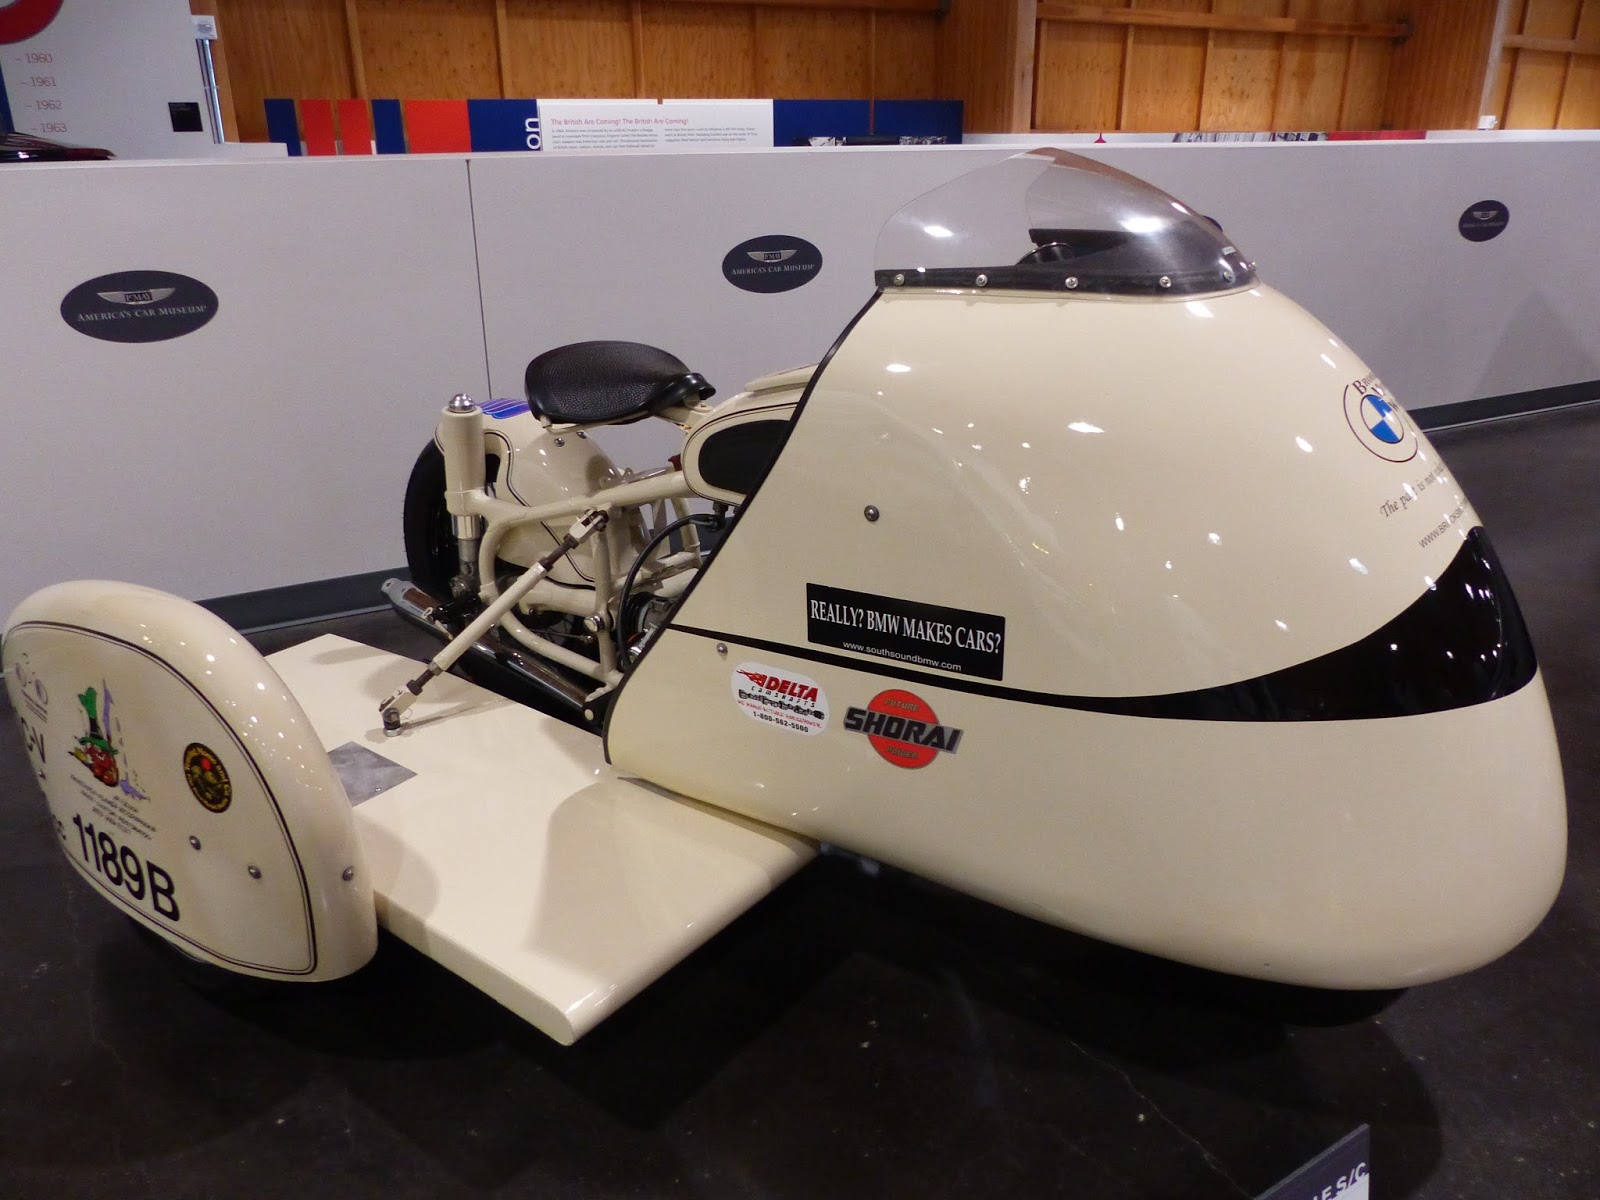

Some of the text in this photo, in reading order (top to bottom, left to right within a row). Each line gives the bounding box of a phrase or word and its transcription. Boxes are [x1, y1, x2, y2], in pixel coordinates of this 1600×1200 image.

[26, 53, 53, 64] 1960
[31, 76, 57, 87] 1961
[36, 99, 62, 110] 1962
[40, 122, 67, 133] 1963
[551, 118, 563, 126] The
[564, 118, 582, 126] British
[584, 118, 594, 126] Are
[596, 118, 620, 127] Coming!
[622, 118, 633, 126] The
[665, 118, 688, 126] Coming!
[731, 266, 767, 275] AMERICA'S
[768, 265, 782, 273] CAR
[77, 310, 132, 322] AMERICA'S
[134, 309, 156, 318] CAR
[1380, 499, 1399, 517] The
[1400, 486, 1418, 510] pat
[1417, 481, 1426, 491] is
[810, 599, 1002, 654] REALLY? BMW MAKES CARS?
[842, 640, 962, 672] www.southsoundbmw.com
[764, 675, 819, 703] DELTA
[844, 707, 961, 752] SHORAI
[886, 746, 919, 759] POWER
[72, 813, 181, 922] 1189B
[1335, 1162, 1366, 1191] S/C
